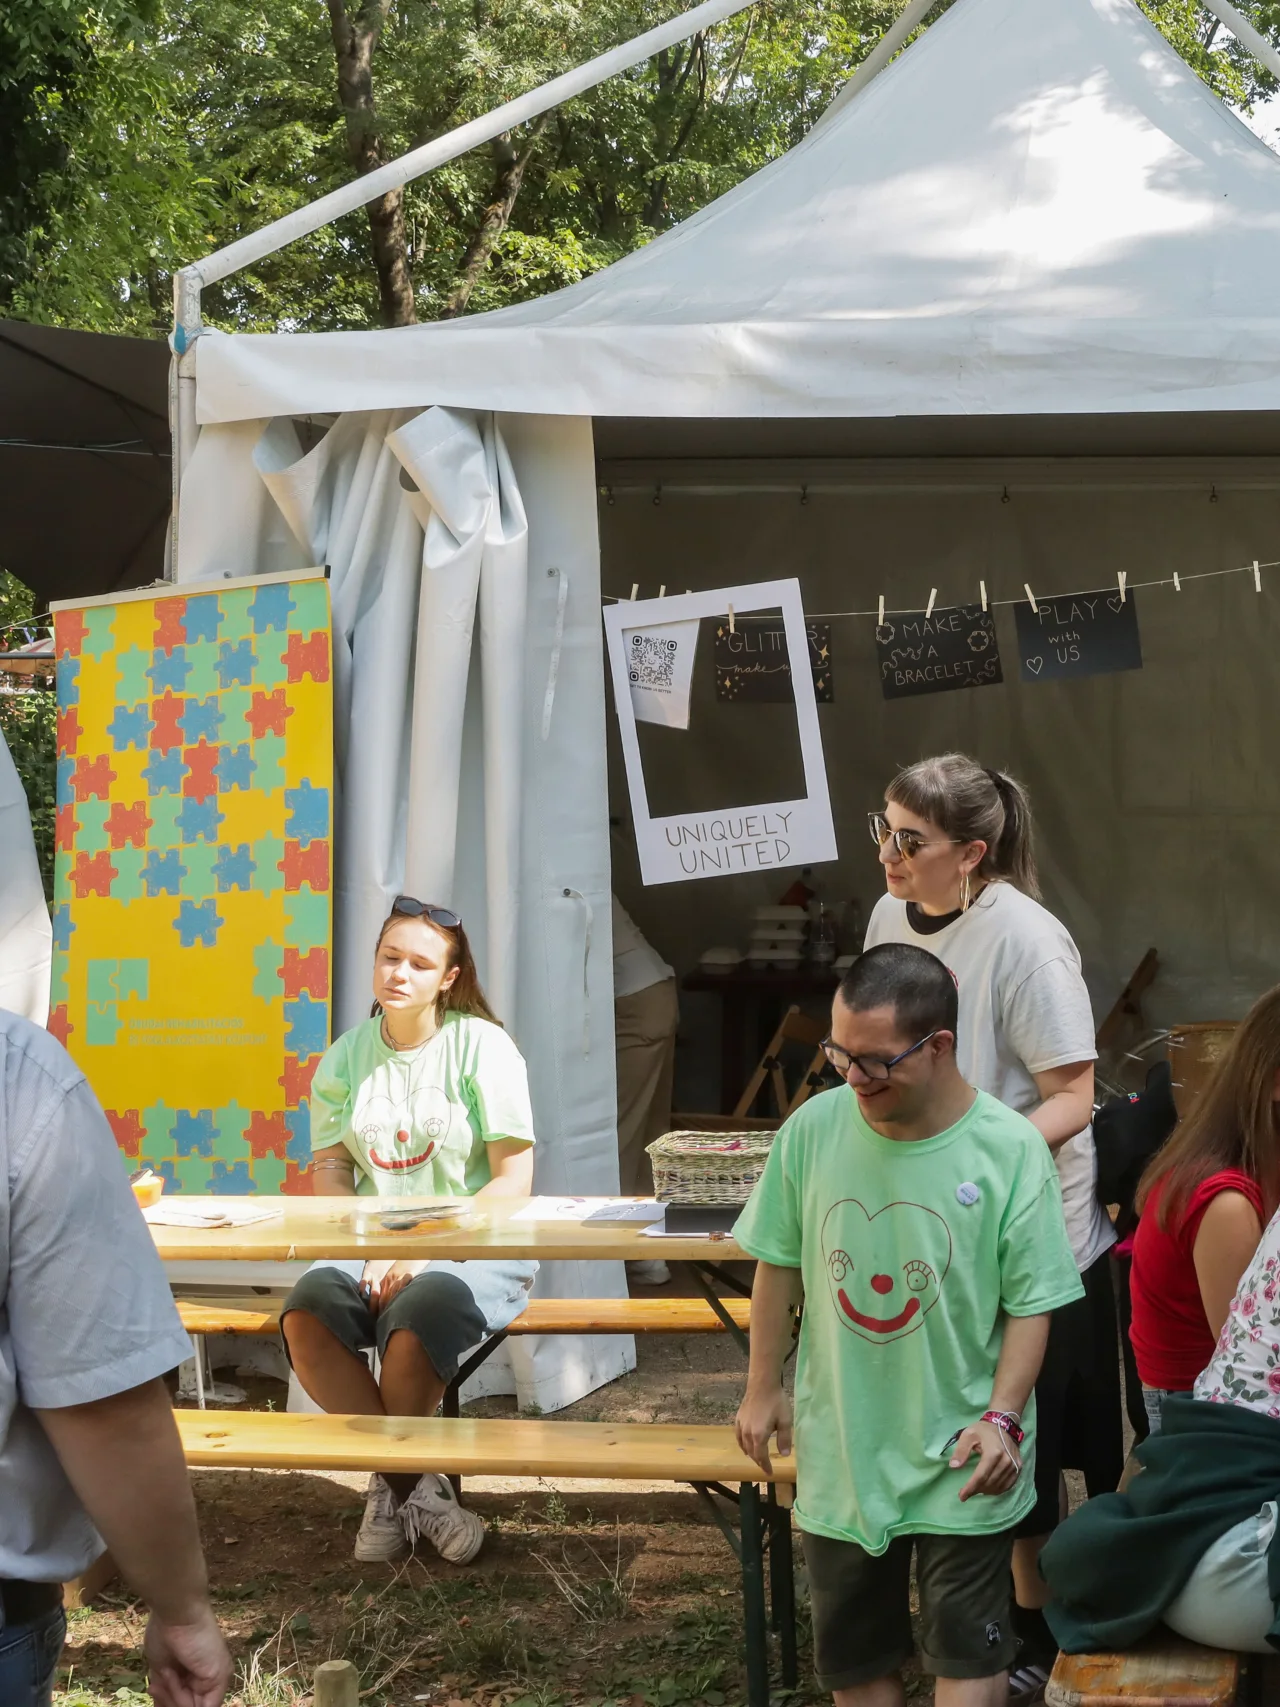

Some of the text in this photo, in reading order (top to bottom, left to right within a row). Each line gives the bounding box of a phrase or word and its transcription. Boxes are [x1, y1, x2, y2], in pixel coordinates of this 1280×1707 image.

[1038, 599, 1098, 625] PLAY
[903, 615, 962, 638] MAKE
[1048, 631, 1081, 644] with
[728, 630, 819, 652] GLITTR
[927, 645, 938, 658] A
[1056, 645, 1081, 664] US
[894, 660, 975, 686] BRACELET
[665, 811, 793, 847] UNIQUELY
[679, 839, 791, 874] UNITED
